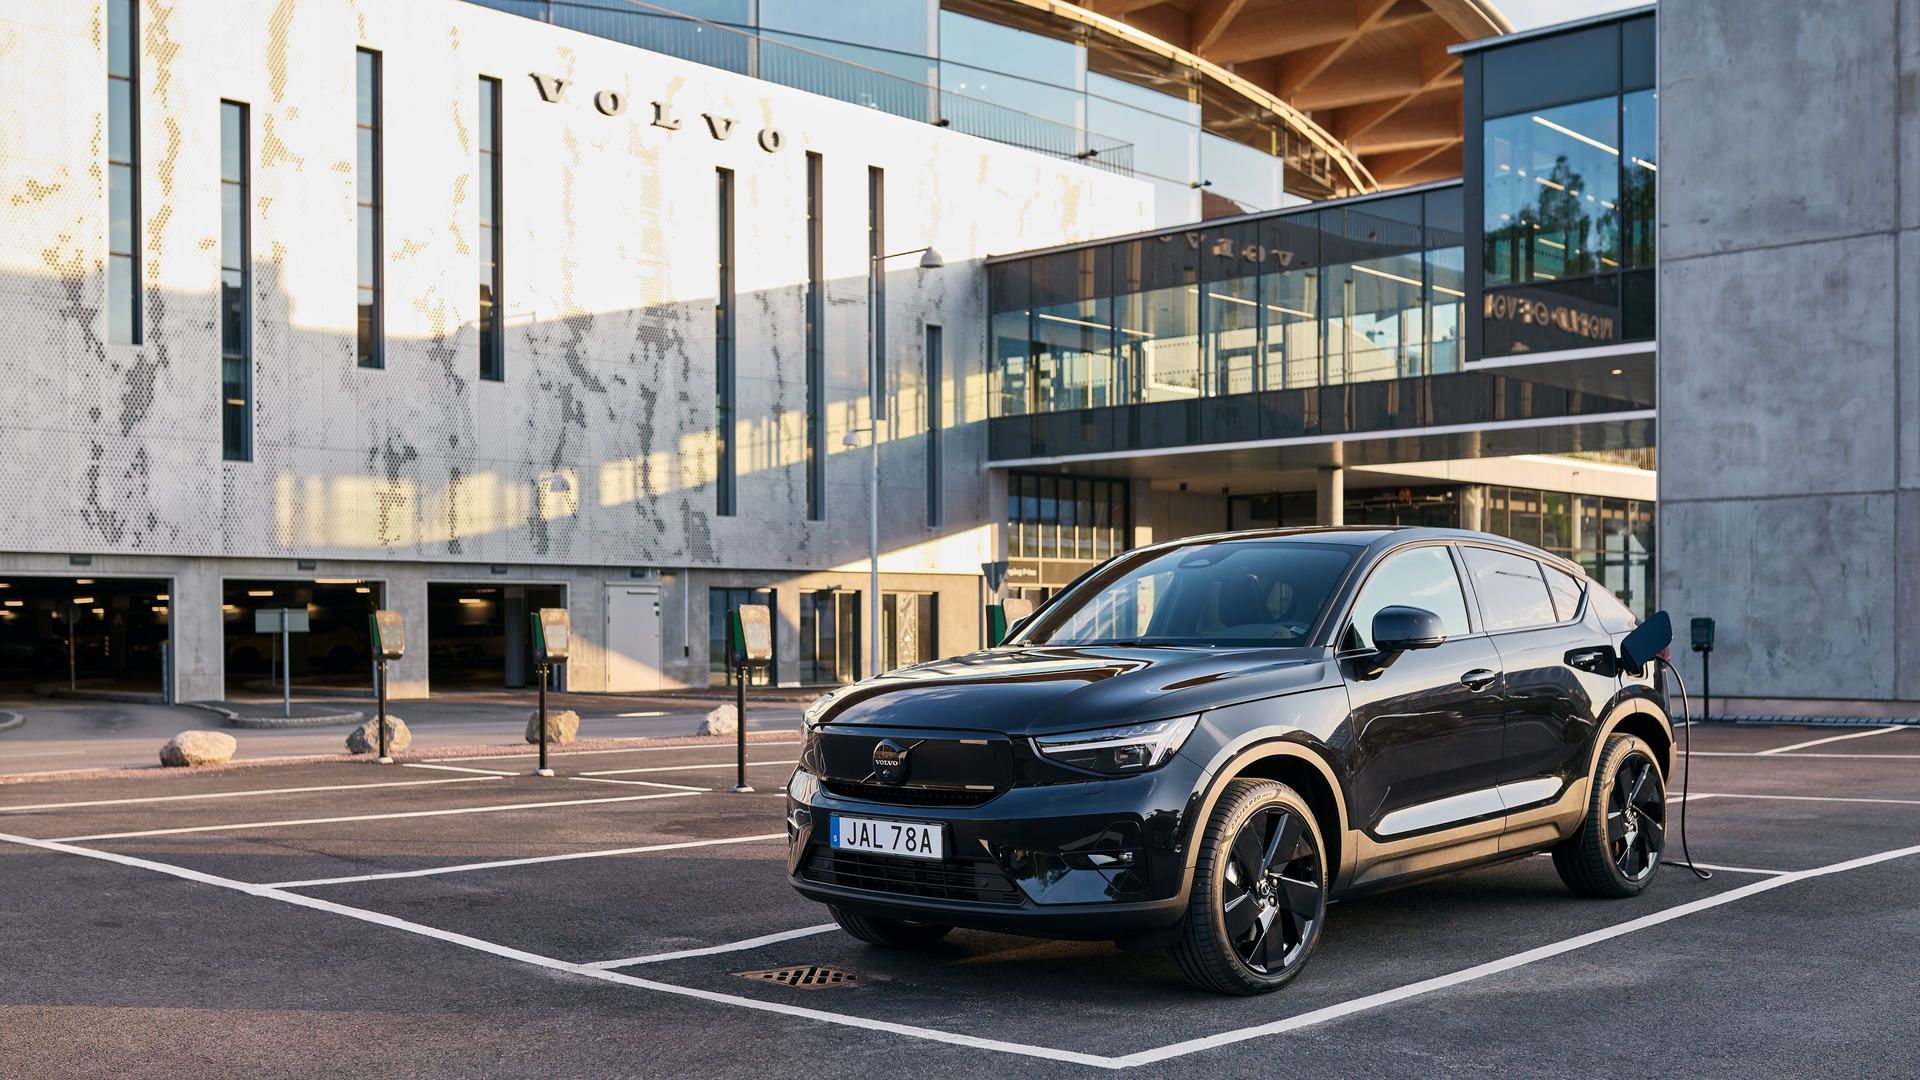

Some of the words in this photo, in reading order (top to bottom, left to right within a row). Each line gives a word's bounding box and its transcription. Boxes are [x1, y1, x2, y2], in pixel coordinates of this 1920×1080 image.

[528, 73, 787, 153] VOLVO
[833, 834, 838, 842] S
[847, 821, 883, 849] JAL
[891, 825, 932, 854] 78A
